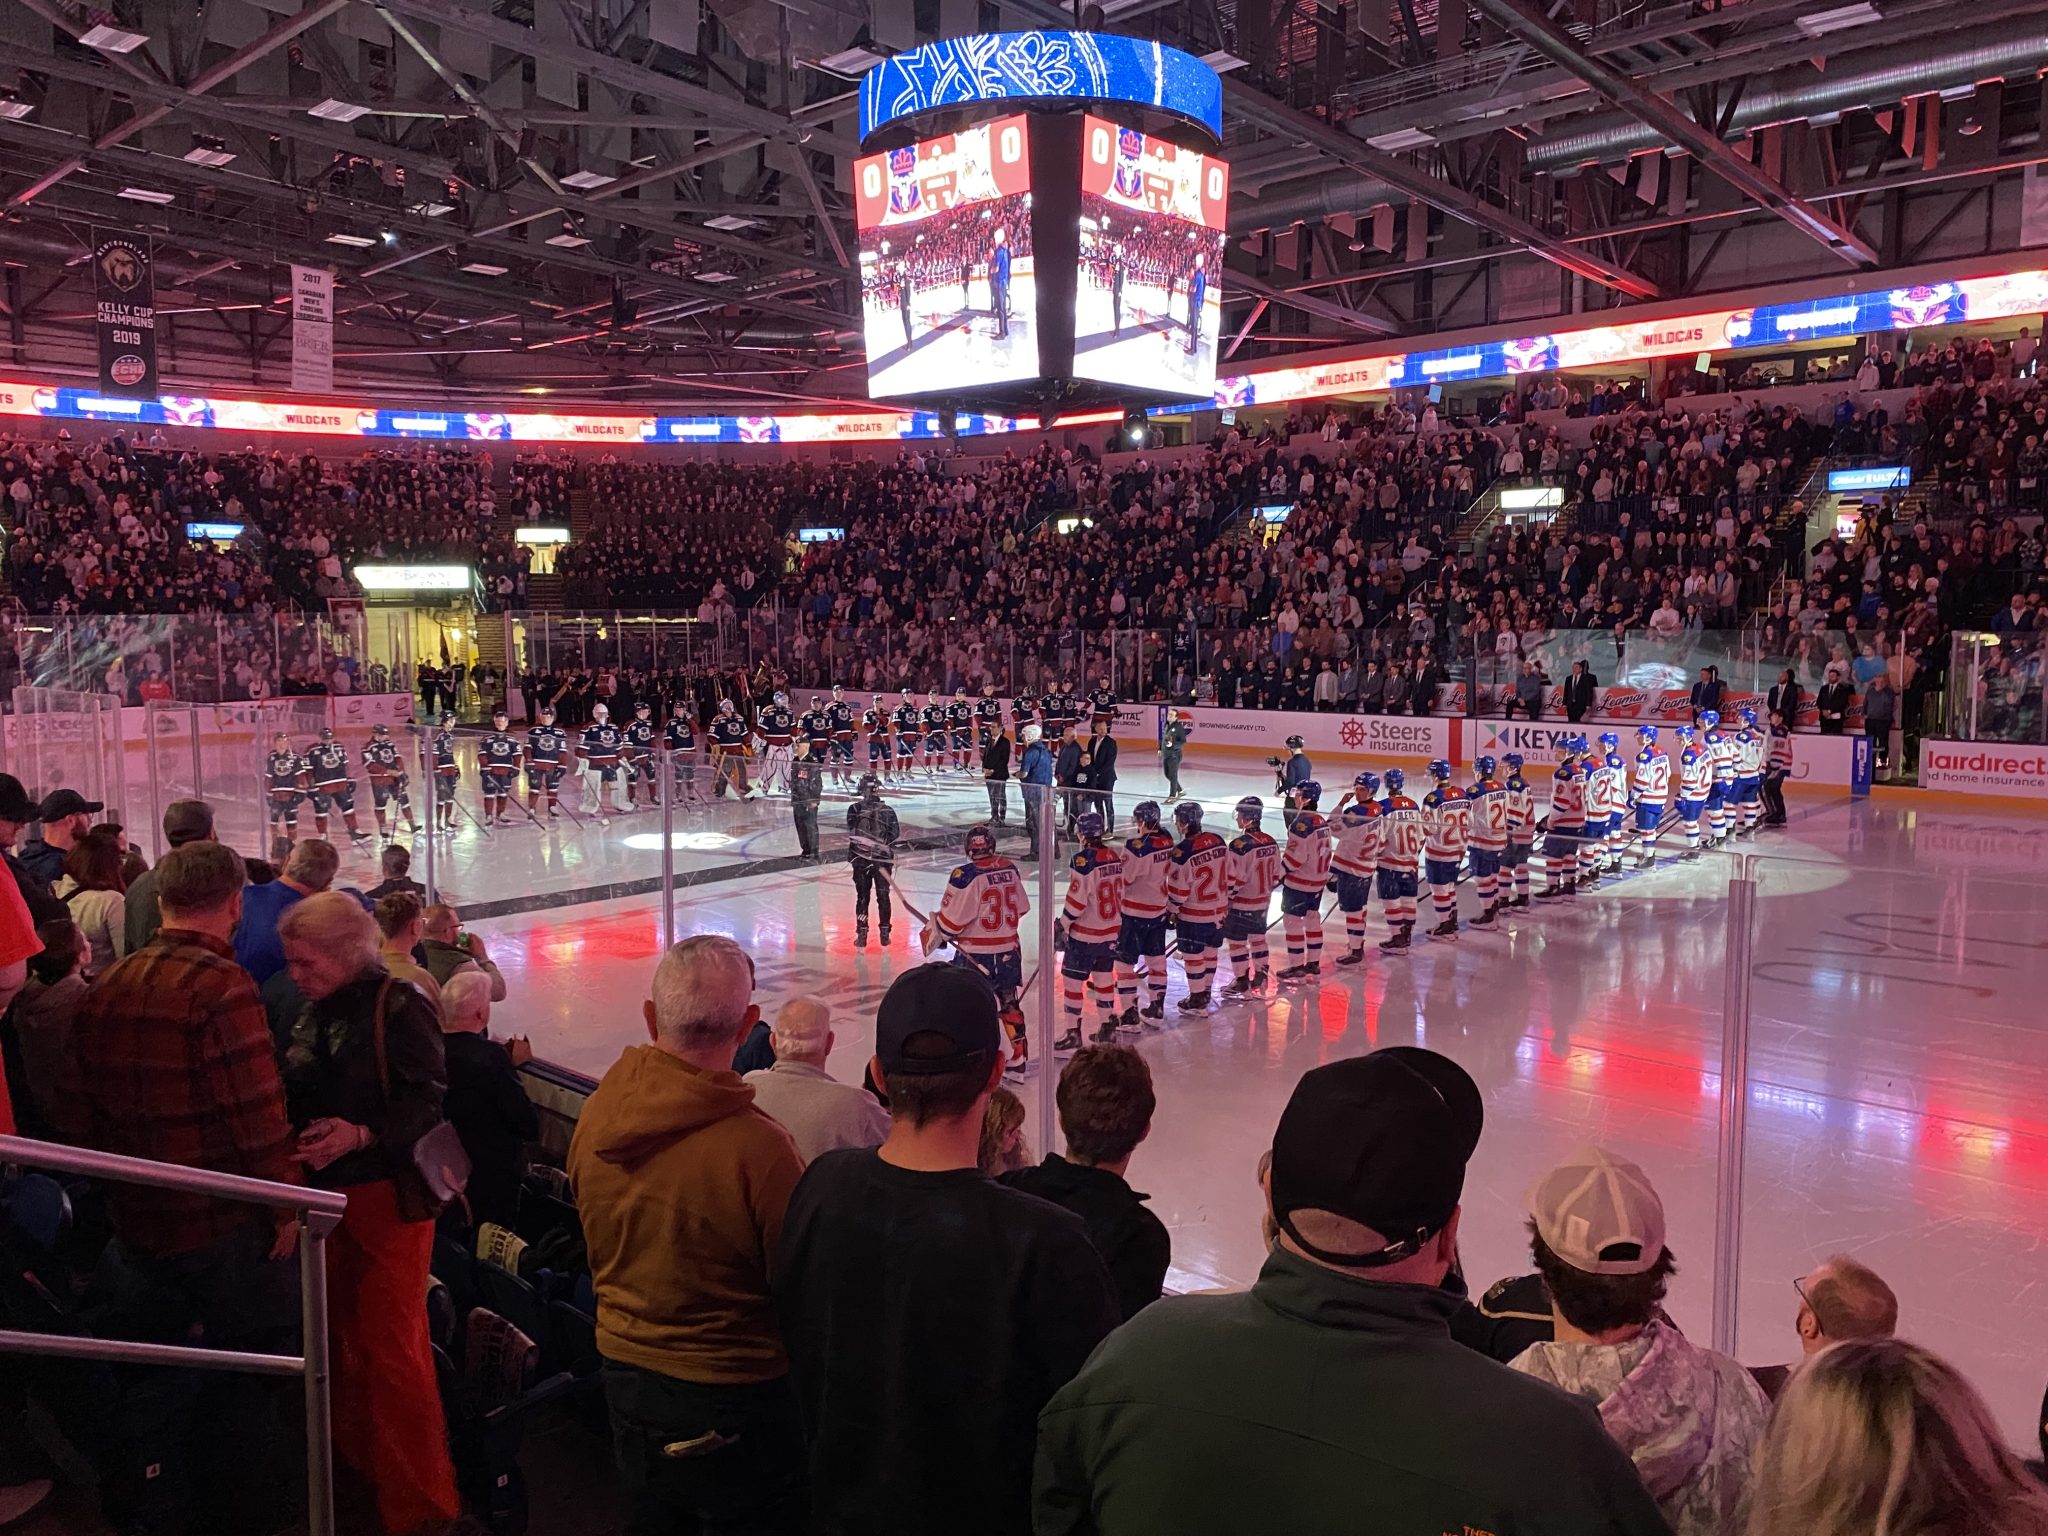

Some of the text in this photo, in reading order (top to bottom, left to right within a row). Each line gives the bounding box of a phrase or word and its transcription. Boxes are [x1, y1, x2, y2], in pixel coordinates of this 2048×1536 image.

[1001, 126, 1021, 163] 0
[1092, 127, 1109, 164] 0
[863, 163, 882, 198] 0
[1208, 166, 1223, 200] 0
[302, 273, 322, 285] 2017
[97, 301, 153, 318] KELLY CUP
[97, 312, 154, 329] CHAMPIONS
[112, 330, 141, 346] 2019
[1317, 371, 1368, 386] WILDCATS
[286, 413, 341, 426] WILDCATS
[837, 422, 882, 433] WILDCATS
[575, 424, 624, 435] WILDCATS
[1596, 692, 1648, 711] Leaman
[1650, 696, 1691, 713] Leam
[1199, 722, 1229, 730] BROWNING
[1369, 720, 1432, 741] Steers
[1369, 741, 1432, 753] insurance
[1943, 773, 1979, 784] home
[1983, 774, 2045, 787] insurance
[1396, 824, 1418, 855] 16
[981, 885, 1018, 932] 35
